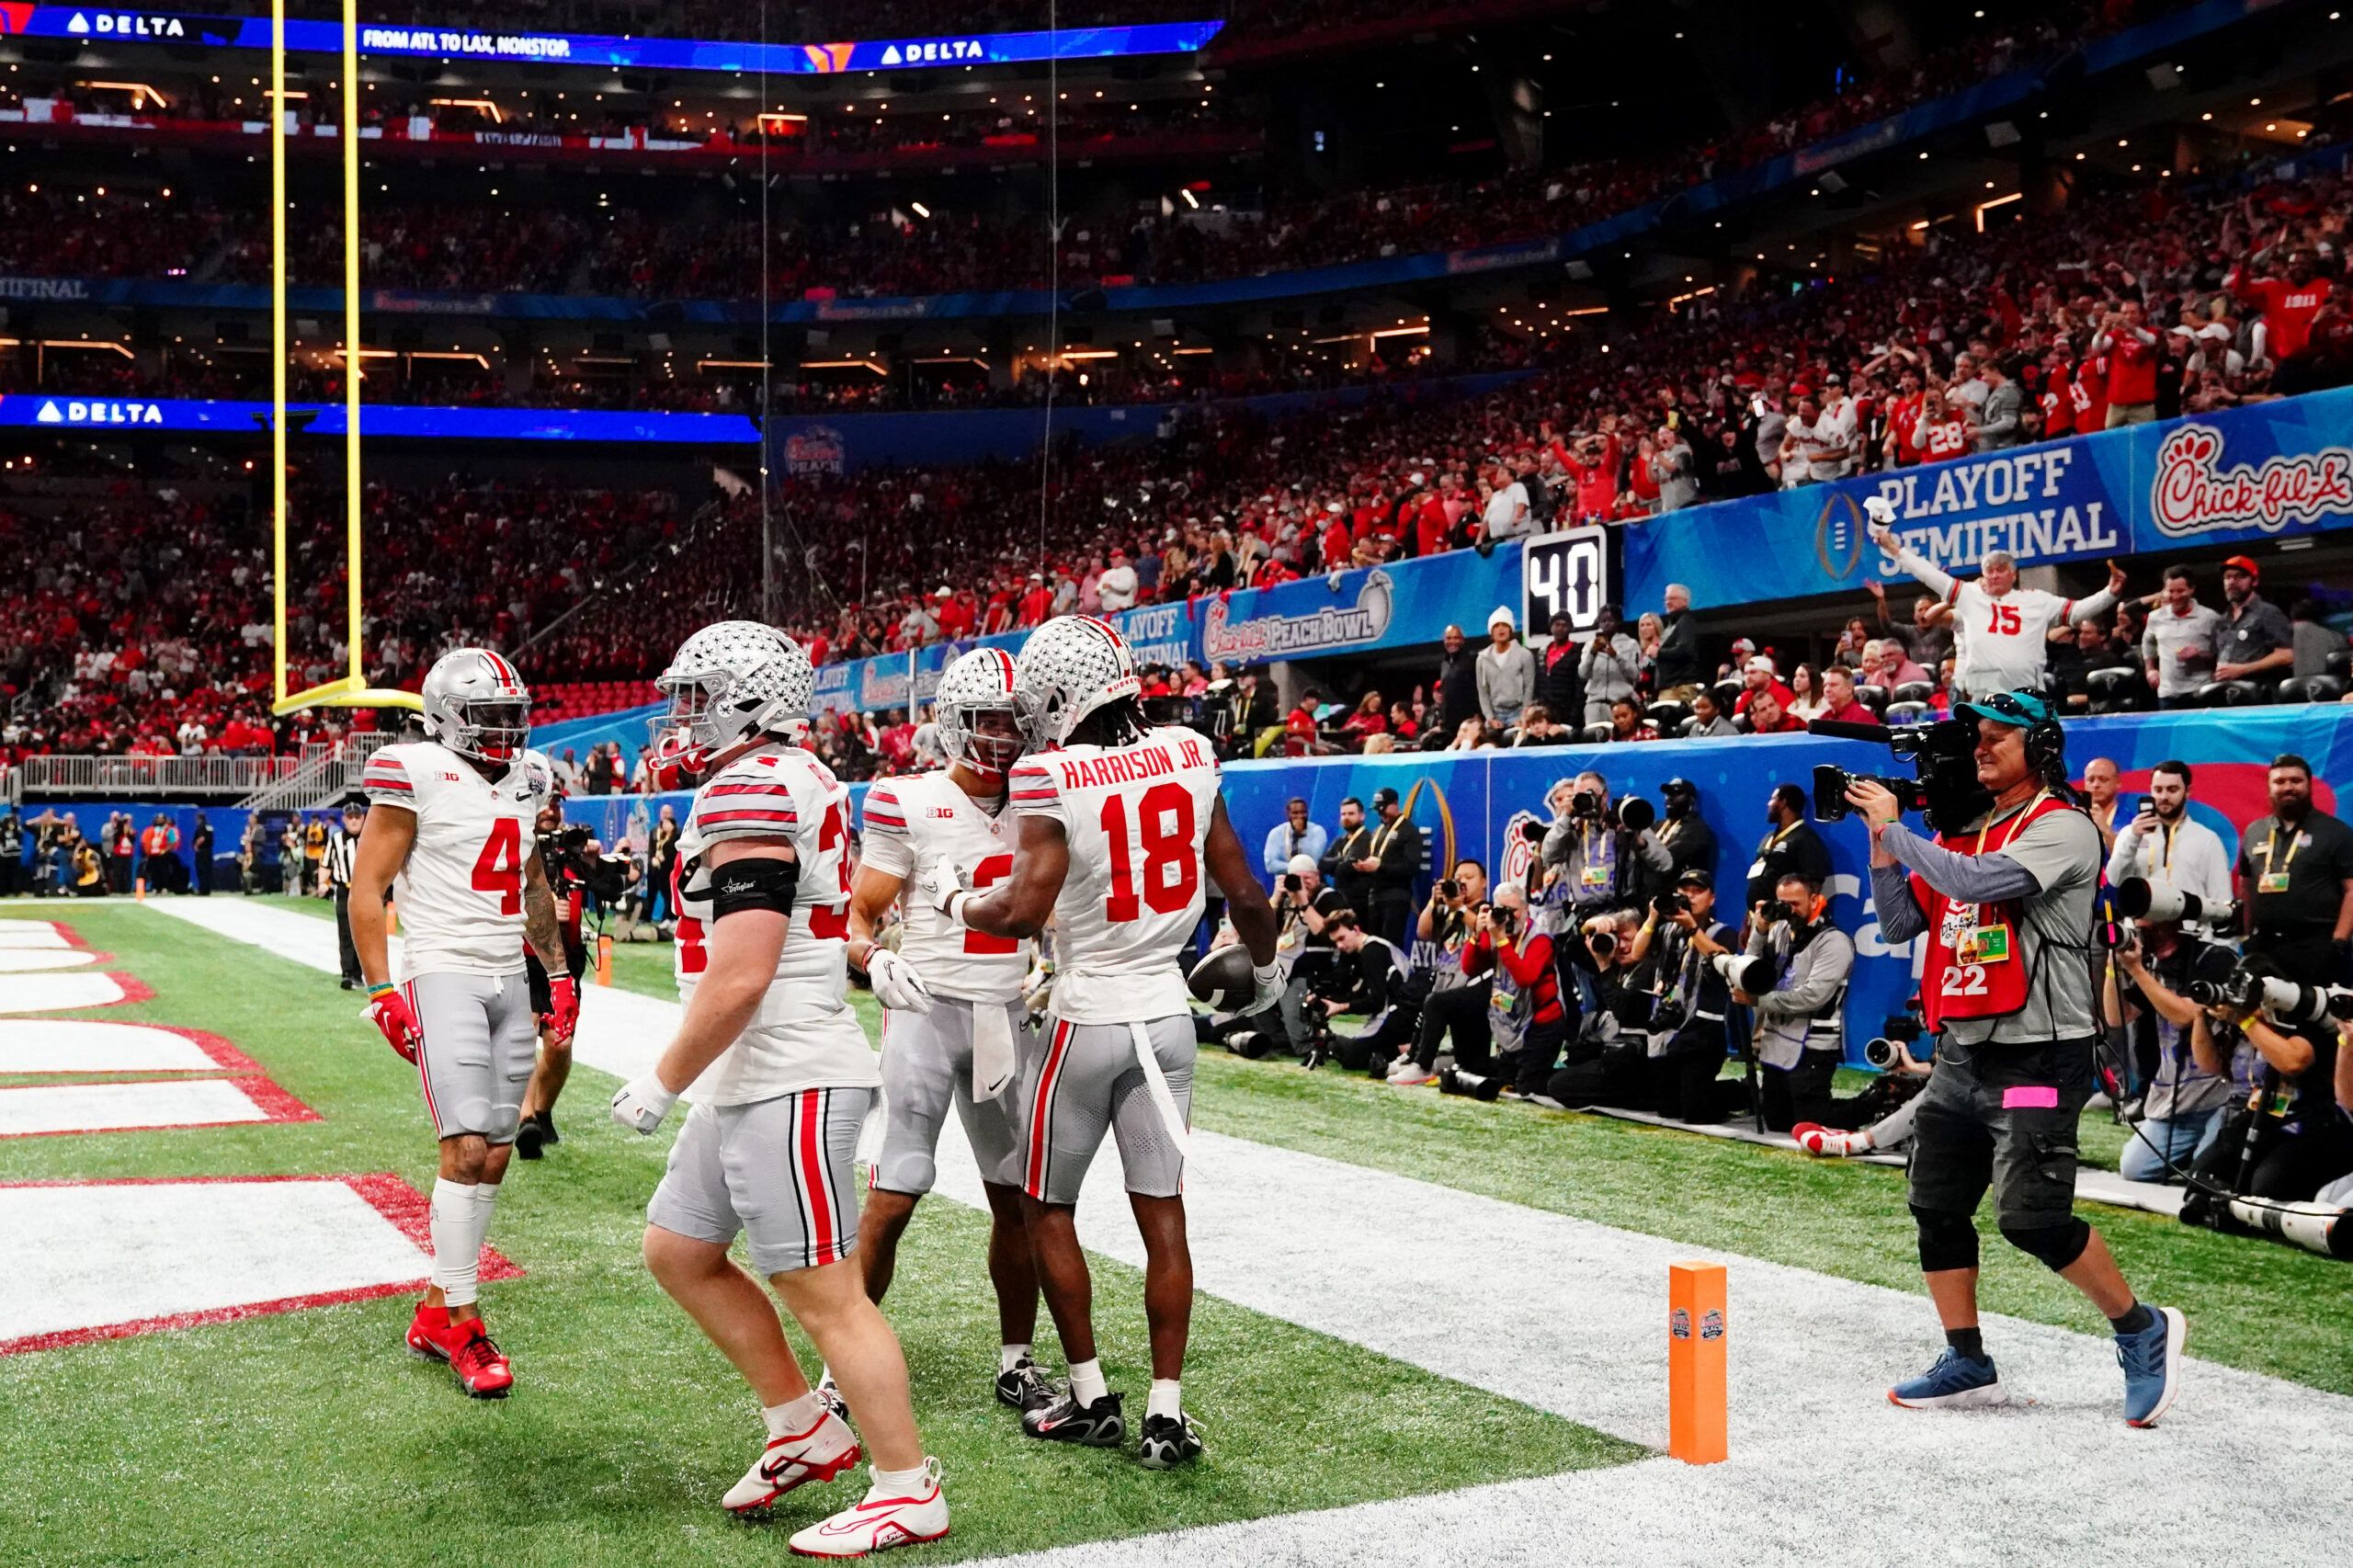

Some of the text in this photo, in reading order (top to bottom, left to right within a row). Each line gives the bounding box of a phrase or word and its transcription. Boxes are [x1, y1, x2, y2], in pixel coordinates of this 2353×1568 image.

[97, 14, 184, 36] DELTA
[364, 29, 570, 57] FROM ATL TO LAX, NONSTOP.
[906, 40, 983, 62] DELTA
[69, 402, 163, 423] DELTA
[1929, 421, 1963, 454] 28
[1879, 448, 2072, 519] PLAYOFF
[2163, 459, 2348, 523] Chick-fil-A
[1879, 502, 2117, 577] SEMIFINAL
[1529, 542, 1597, 627] 40
[1988, 603, 2021, 636] 15
[1061, 739, 1207, 789] HARRISON JR.
[472, 818, 521, 915] 4
[1100, 782, 1198, 922] 18
[1941, 965, 1987, 996] 22
